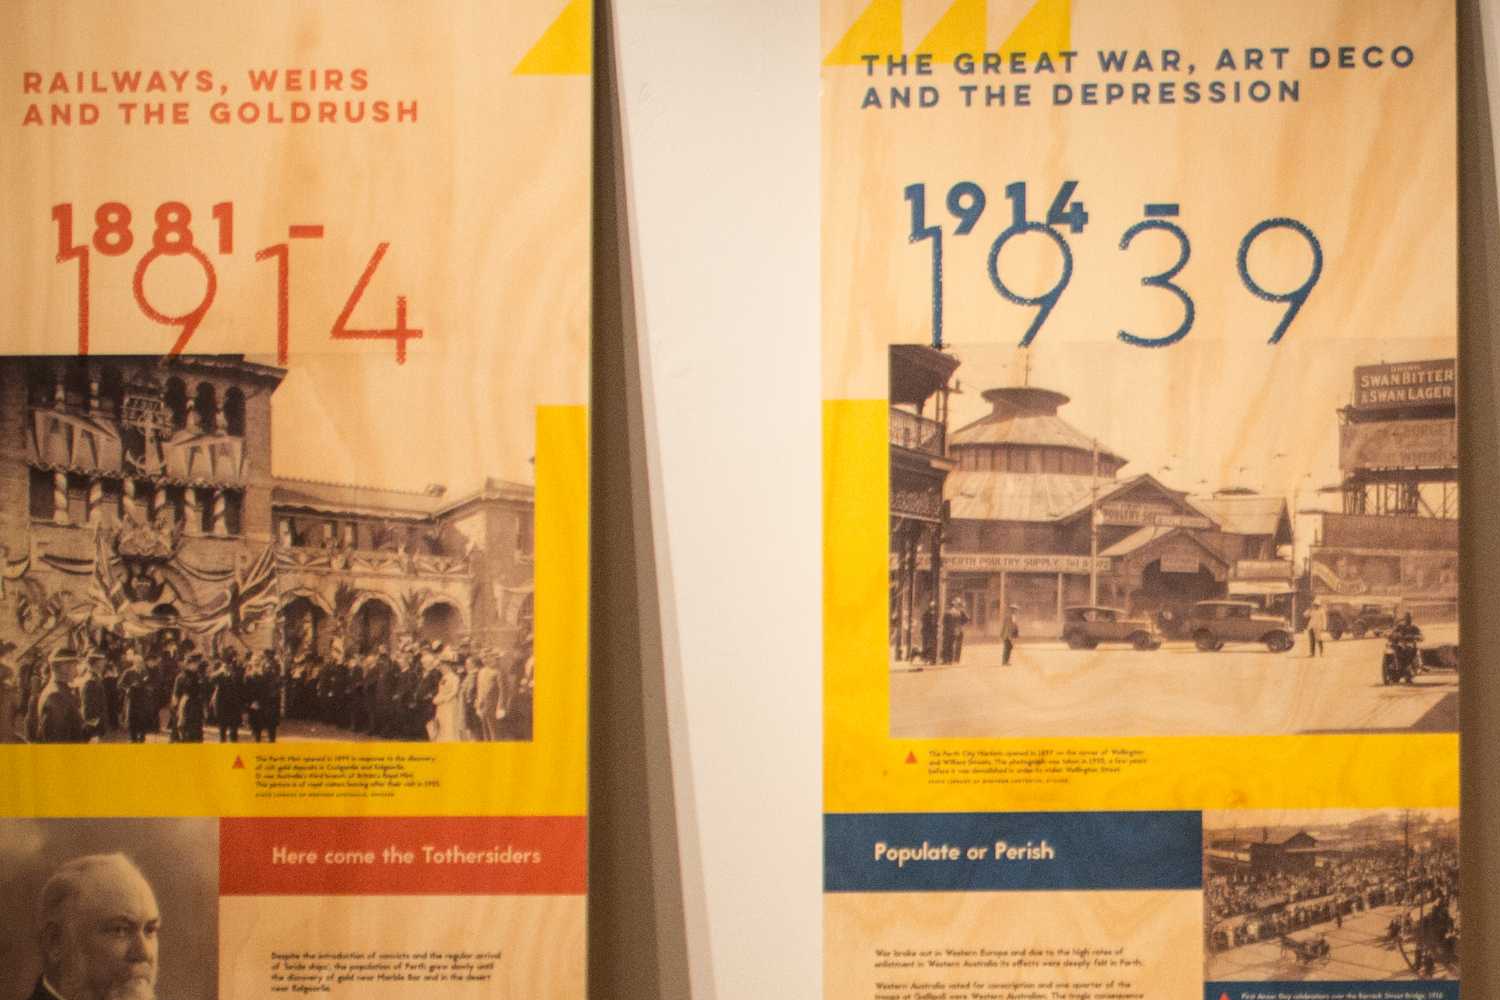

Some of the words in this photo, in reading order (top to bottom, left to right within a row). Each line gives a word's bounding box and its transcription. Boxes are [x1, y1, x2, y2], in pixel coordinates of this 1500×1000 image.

[860, 53, 933, 76] THE
[952, 50, 1078, 75] GREAT
[1096, 48, 1195, 74] WAR,
[1215, 47, 1290, 71] ART
[1309, 44, 1414, 69] DECO
[23, 69, 228, 96] RAILWAYS,
[247, 67, 368, 92] WEIRS
[860, 85, 940, 109] AND
[958, 83, 1031, 107] THE
[1052, 79, 1300, 106] DEPRESSION
[22, 102, 100, 126] AND
[117, 101, 189, 125] THE
[208, 99, 418, 125] GOLDRUSH
[904, 180, 1089, 236] 1914
[51, 201, 234, 256] 1881
[908, 216, 1323, 349] 1939
[56, 242, 423, 366] 1914
[1361, 375, 1399, 388] SWAN
[1402, 369, 1456, 385] BITTER
[1370, 390, 1405, 402] SWAN
[1407, 386, 1454, 400] LAGER
[271, 845, 318, 864] Here
[323, 850, 375, 864] come
[381, 844, 415, 864] the
[421, 844, 541, 864] Tothersiders
[874, 840, 961, 868] Populate
[966, 846, 988, 860] or
[994, 839, 1055, 860] Perish
